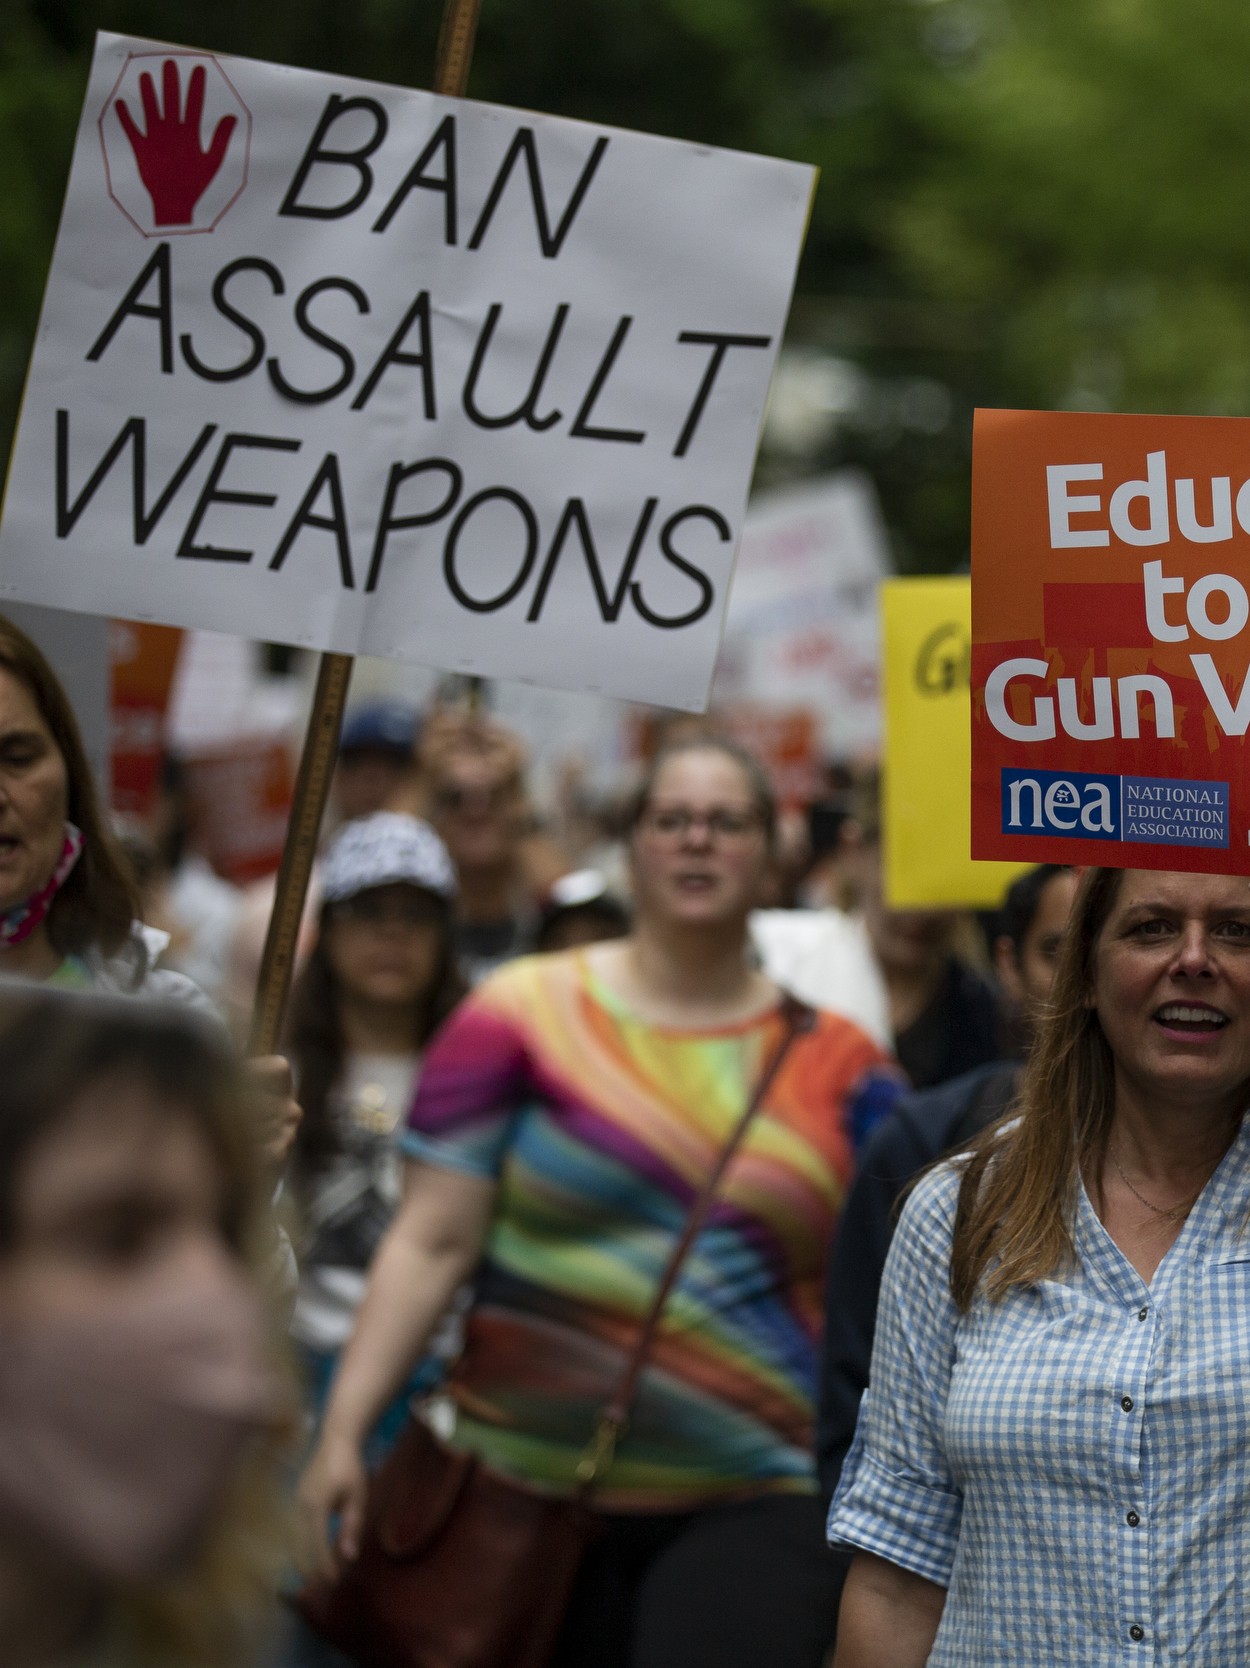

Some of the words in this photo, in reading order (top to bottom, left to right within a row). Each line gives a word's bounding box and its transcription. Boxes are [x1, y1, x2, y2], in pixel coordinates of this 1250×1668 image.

[278, 93, 610, 259] BAN
[85, 242, 772, 458] ASSAULT
[55, 409, 732, 629] WEAPONS
[1142, 559, 1250, 643] to
[984, 657, 1176, 742] Gun
[1008, 778, 1115, 833] nea
[1127, 785, 1224, 806] NATIONAL
[1127, 804, 1224, 824] EDUCATION
[1127, 822, 1224, 841] ASSOCIATION
